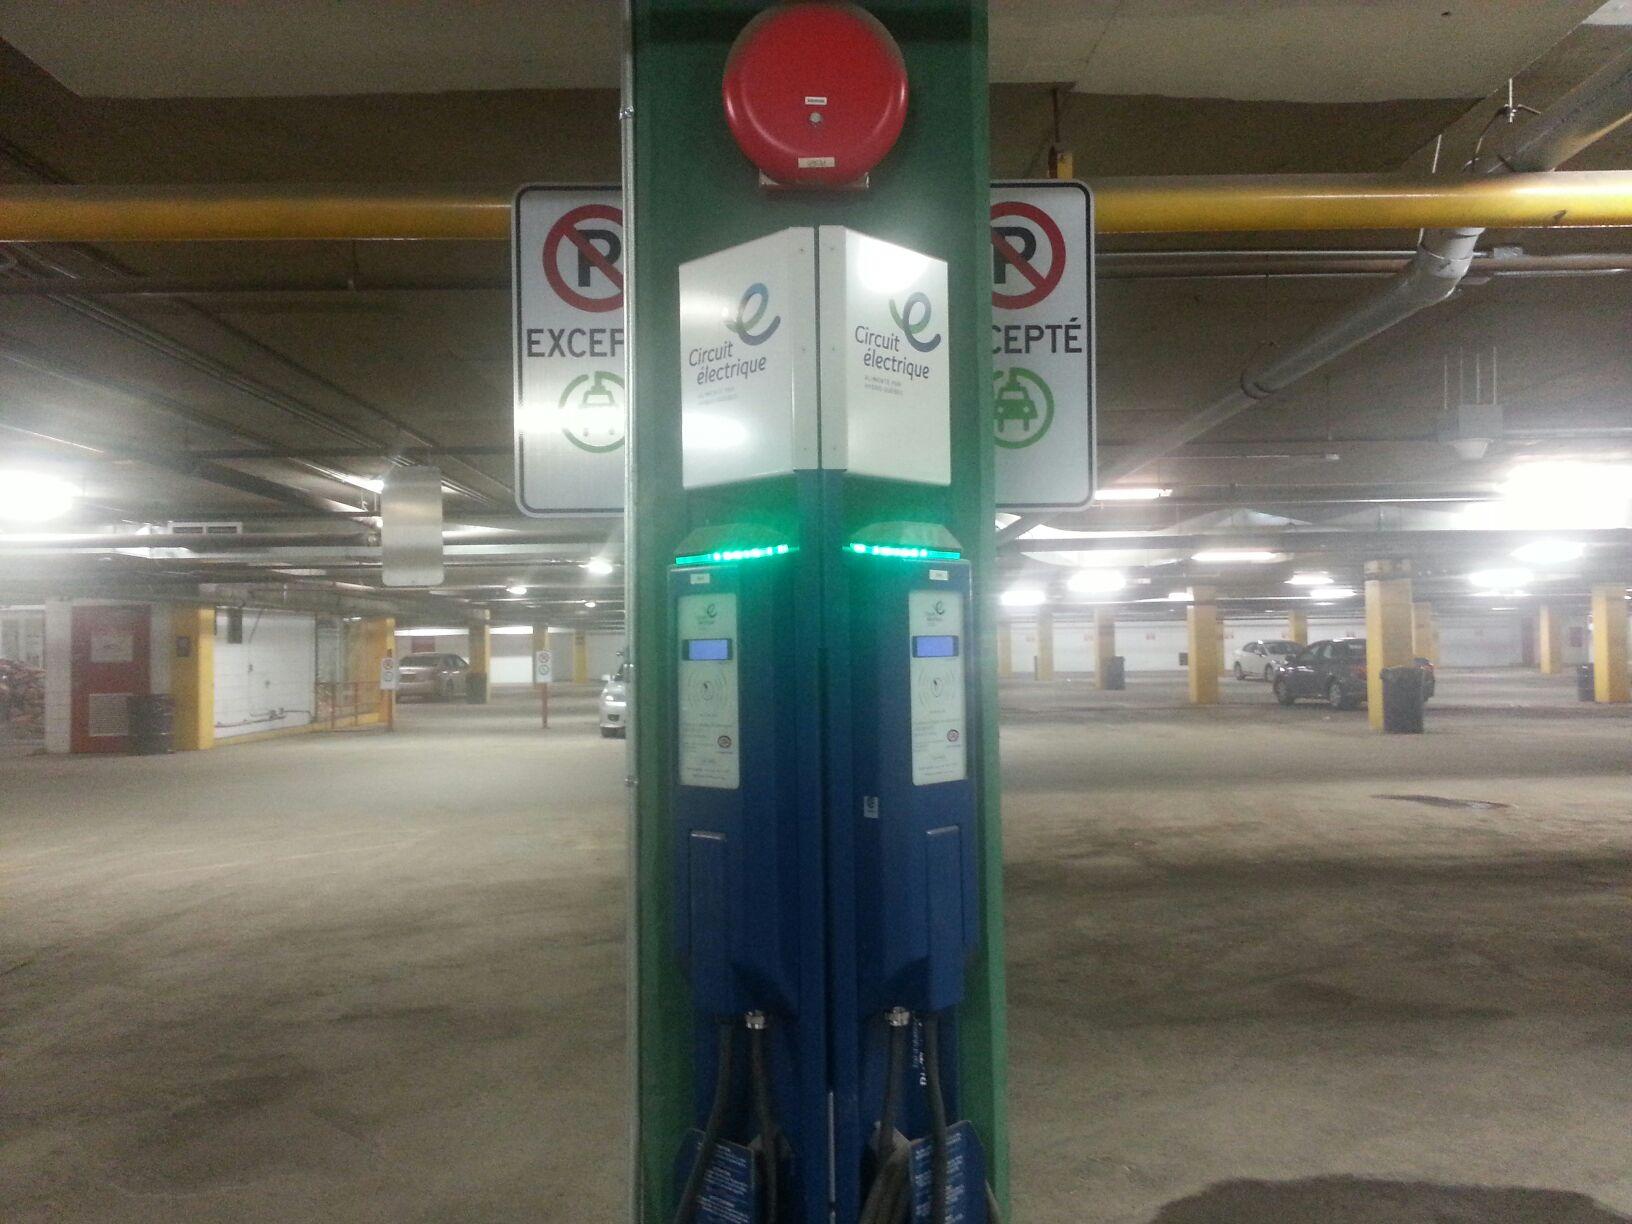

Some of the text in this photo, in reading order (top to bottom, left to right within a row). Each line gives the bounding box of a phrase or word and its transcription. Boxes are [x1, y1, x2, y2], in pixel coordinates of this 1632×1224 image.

[855, 325, 901, 352] Circuit
[689, 340, 734, 367] Circuit
[863, 347, 930, 380] électrique
[697, 356, 767, 385] électrique
